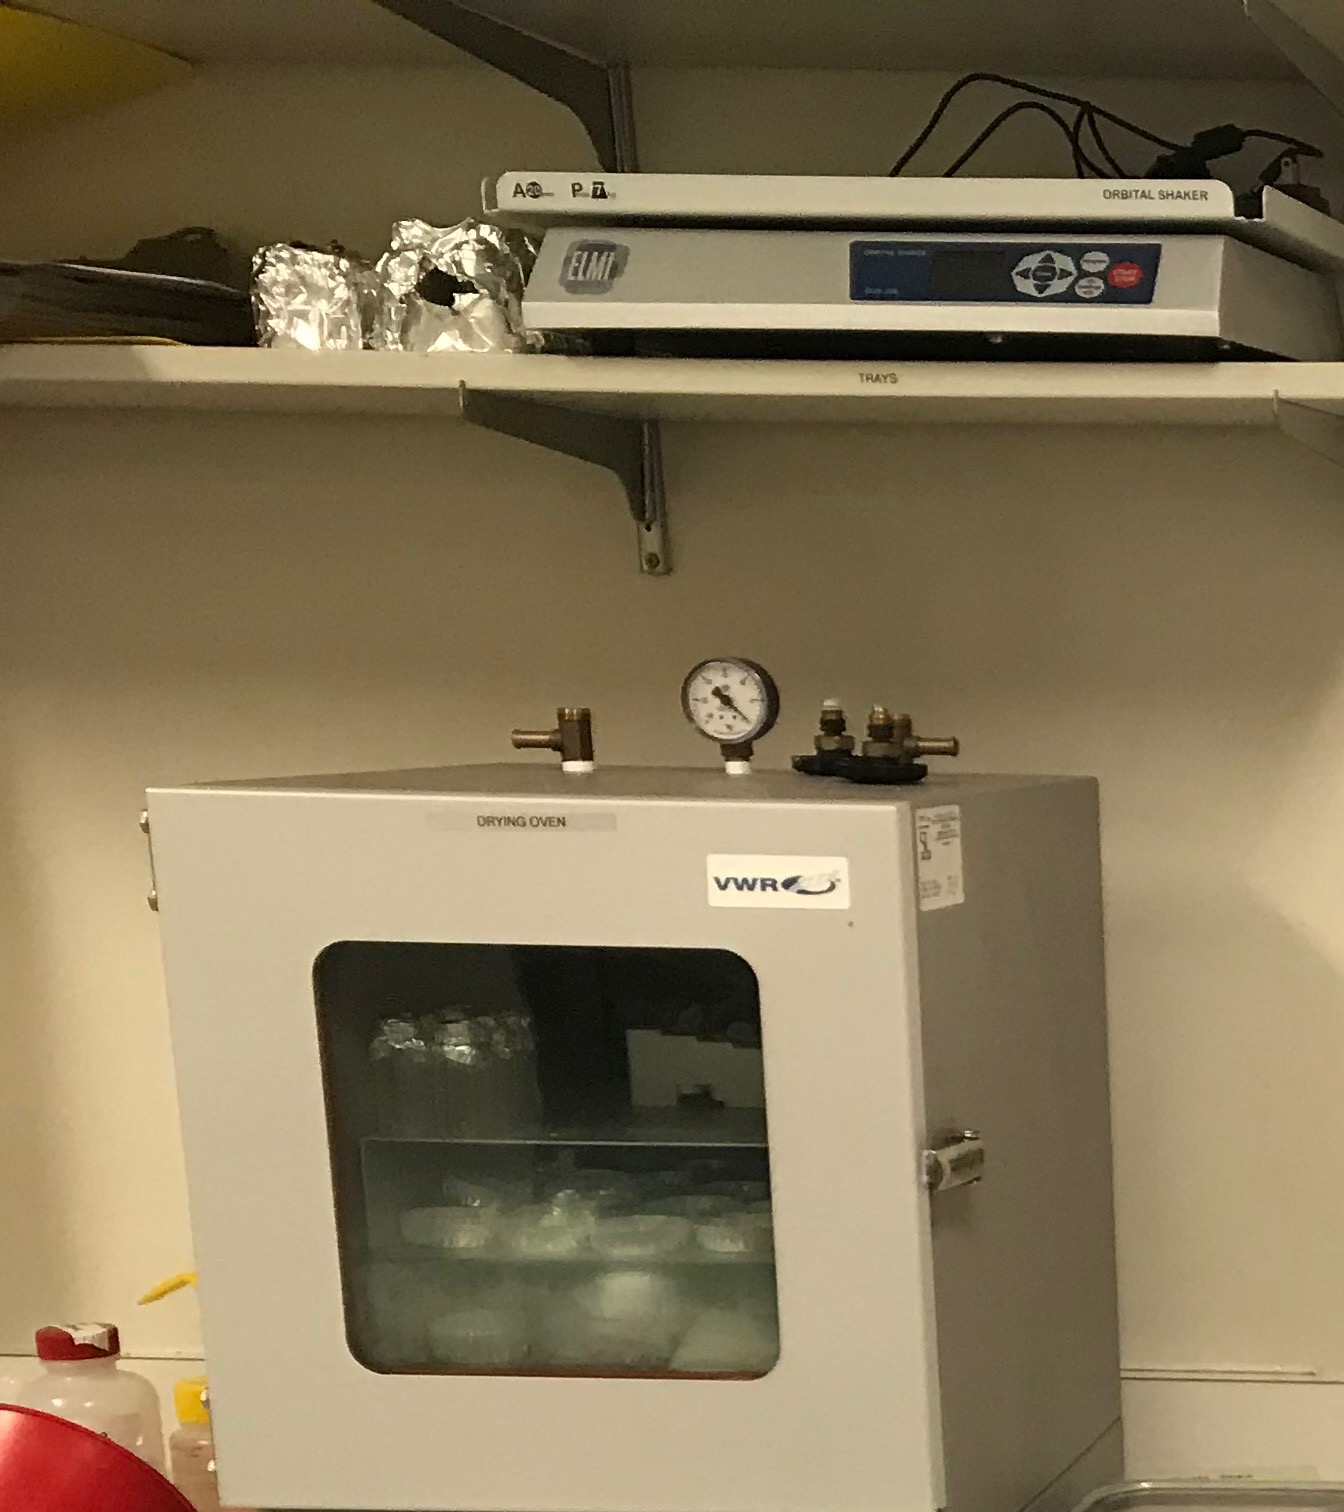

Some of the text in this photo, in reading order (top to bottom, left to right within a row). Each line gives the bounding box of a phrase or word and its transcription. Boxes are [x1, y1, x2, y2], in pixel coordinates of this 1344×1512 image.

[1102, 189, 1209, 201] ORBITAL SHAKER
[567, 251, 615, 281] ELMI
[859, 372, 898, 384] TRAYS
[476, 815, 566, 828] DRYING OVEN
[713, 876, 779, 892] VWR
